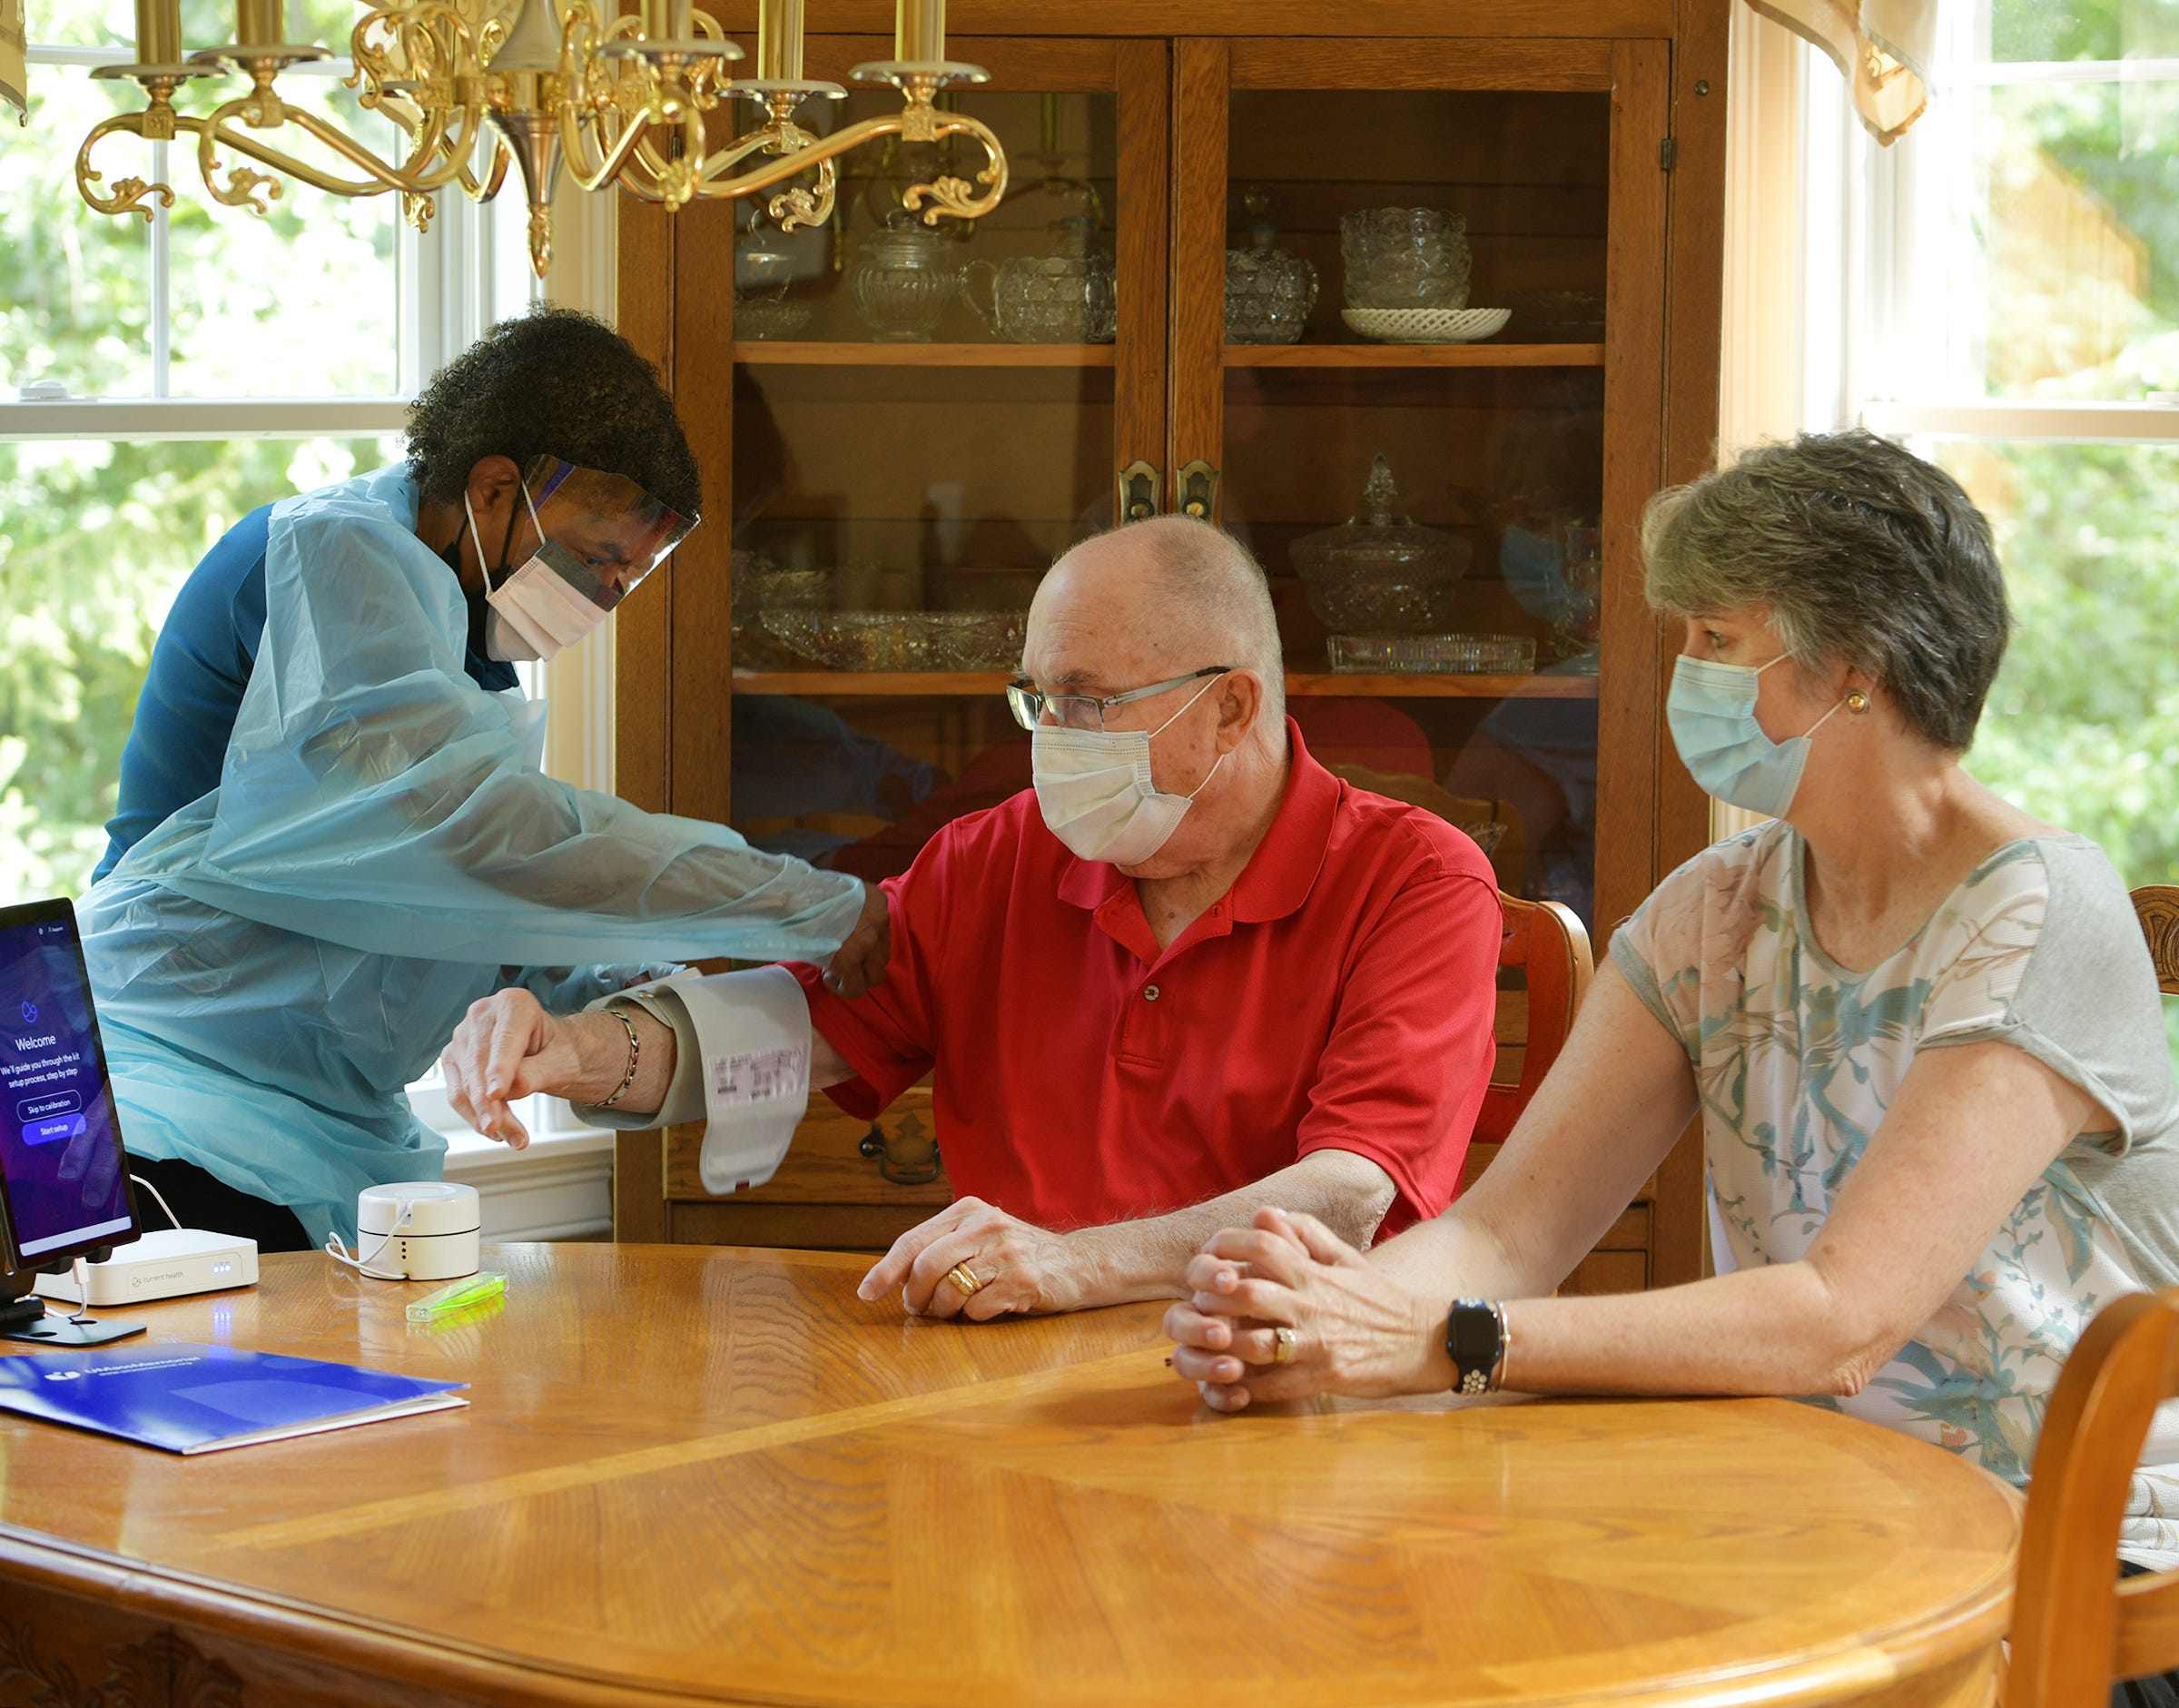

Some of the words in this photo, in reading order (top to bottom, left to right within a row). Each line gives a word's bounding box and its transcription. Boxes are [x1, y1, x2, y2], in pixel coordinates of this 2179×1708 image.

[15, 1035, 56, 1051] Welcome
[15, 1062, 31, 1075] guide
[31, 1061, 42, 1071] you
[41, 1055, 63, 1067] through
[63, 1053, 73, 1063] the
[72, 1052, 80, 1061] kit
[8, 1079, 25, 1089] setup
[46, 1071, 59, 1081] step
[58, 1070, 66, 1080] by
[65, 1068, 78, 1077] step
[27, 1106, 39, 1114] Skip
[45, 1100, 71, 1111] calibration
[40, 1127, 54, 1136] Start
[54, 1124, 69, 1133] setup
